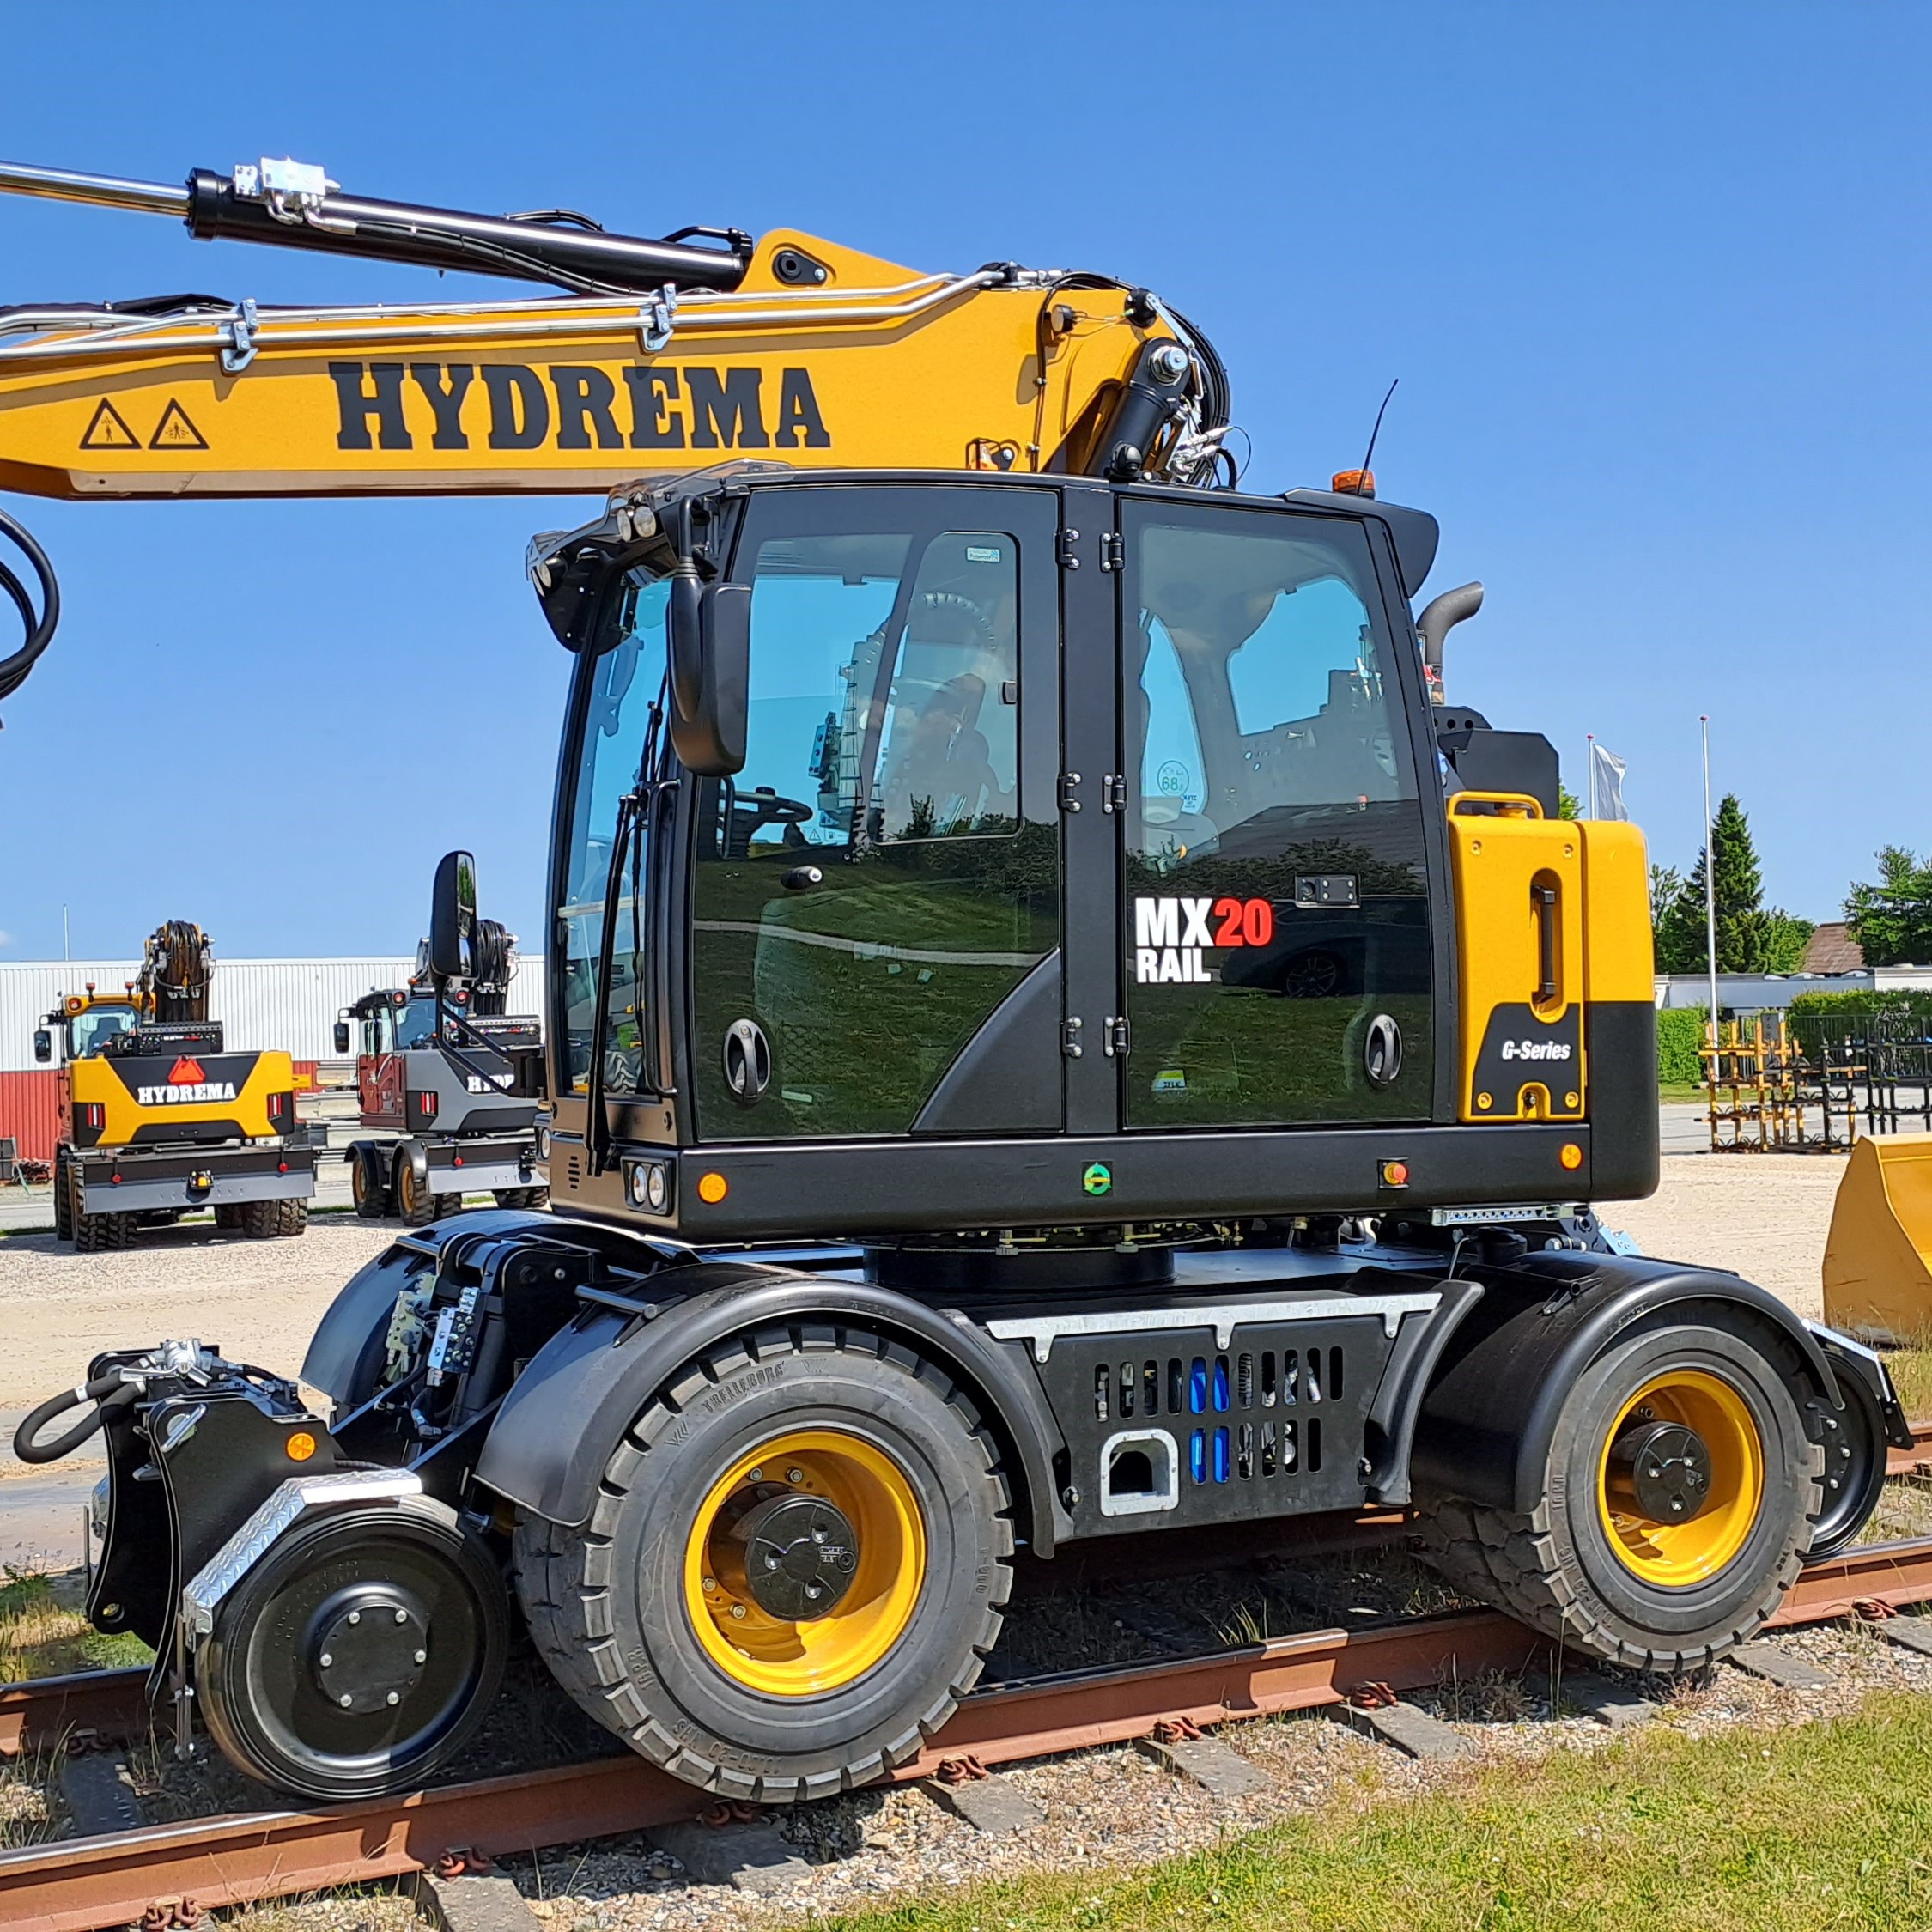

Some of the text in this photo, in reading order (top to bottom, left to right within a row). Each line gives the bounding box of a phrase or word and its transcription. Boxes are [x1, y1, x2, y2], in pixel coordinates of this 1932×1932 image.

[328, 362, 831, 449] HYDREMA
[1135, 897, 1273, 947] MX20
[1136, 947, 1212, 983] RAIL
[1502, 1040, 1571, 1060] G-Series
[137, 1082, 236, 1104] HYDREMA
[701, 1363, 785, 1413] TRELLEBORG
